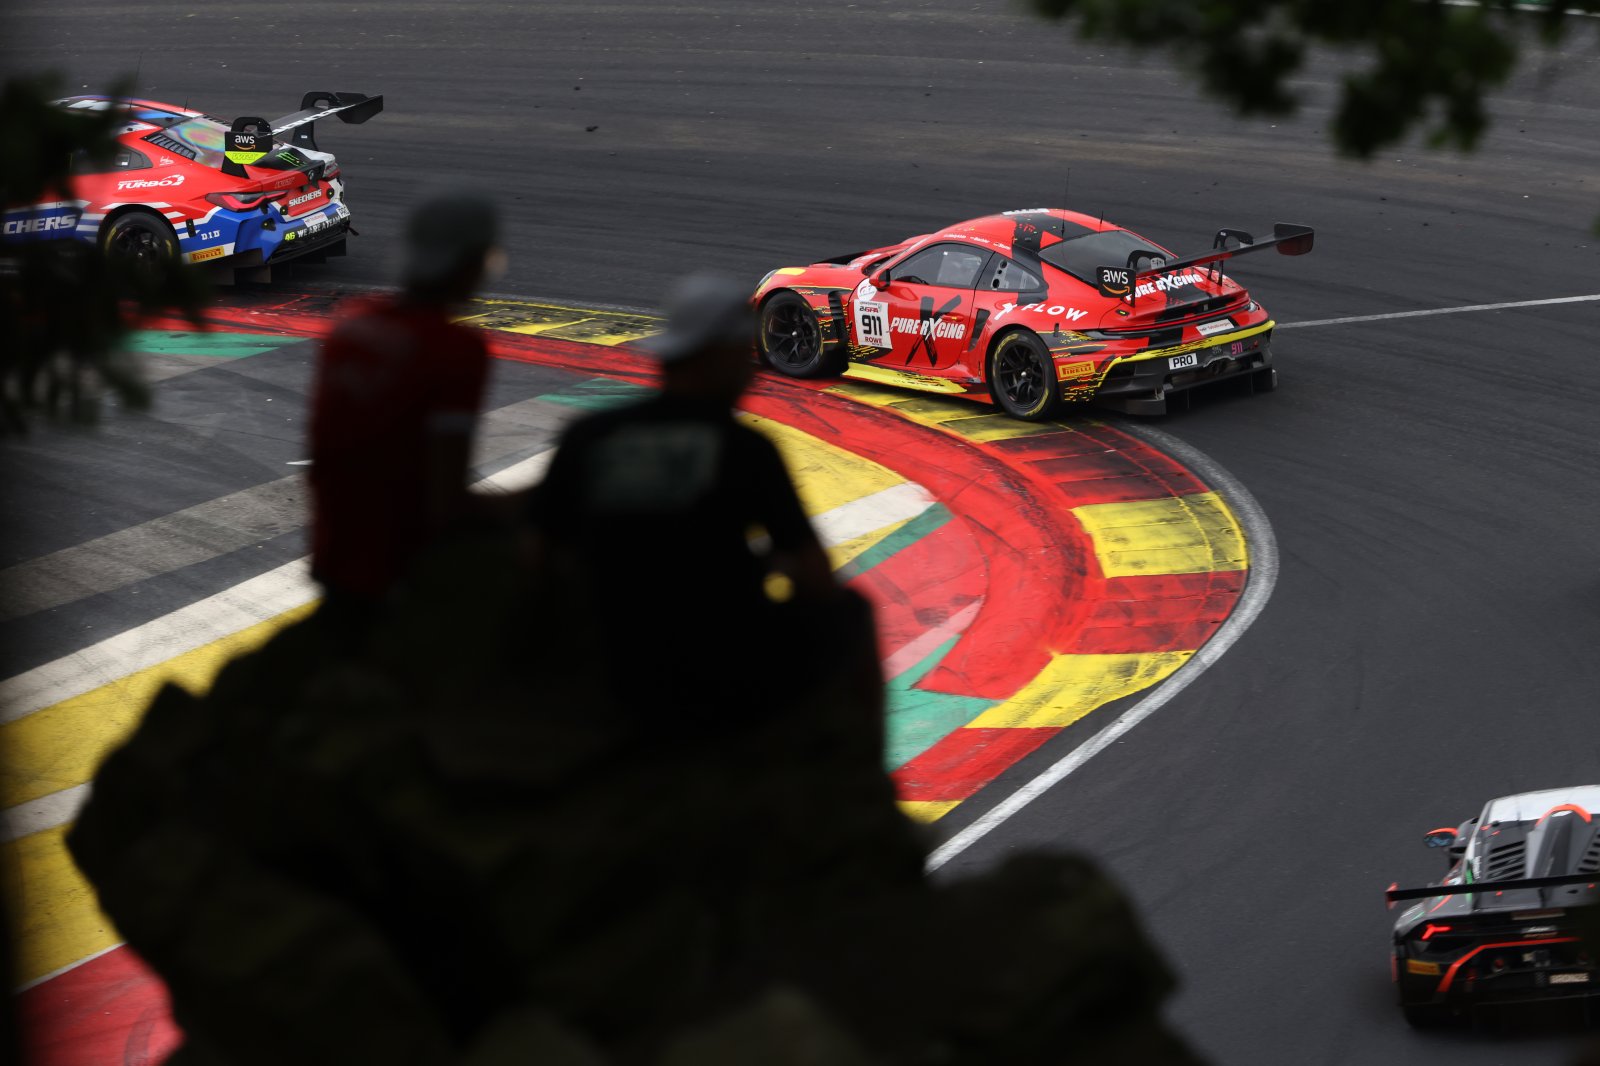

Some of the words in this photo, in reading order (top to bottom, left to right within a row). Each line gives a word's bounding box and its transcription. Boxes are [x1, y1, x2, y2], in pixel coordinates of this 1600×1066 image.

[235, 135, 255, 144] aws
[117, 180, 173, 190] TURBO
[289, 189, 322, 206] SKECHERS
[285, 232, 296, 241] 46
[1103, 269, 1129, 285] aws
[1125, 282, 1157, 301] URE
[1021, 303, 1089, 322] FLOW
[862, 314, 882, 336] 911
[890, 316, 919, 335] PURE
[865, 336, 882, 345] ROWE
[1231, 341, 1243, 356] 911
[1173, 354, 1194, 367] PRO
[1062, 363, 1092, 376] PIRELLI
